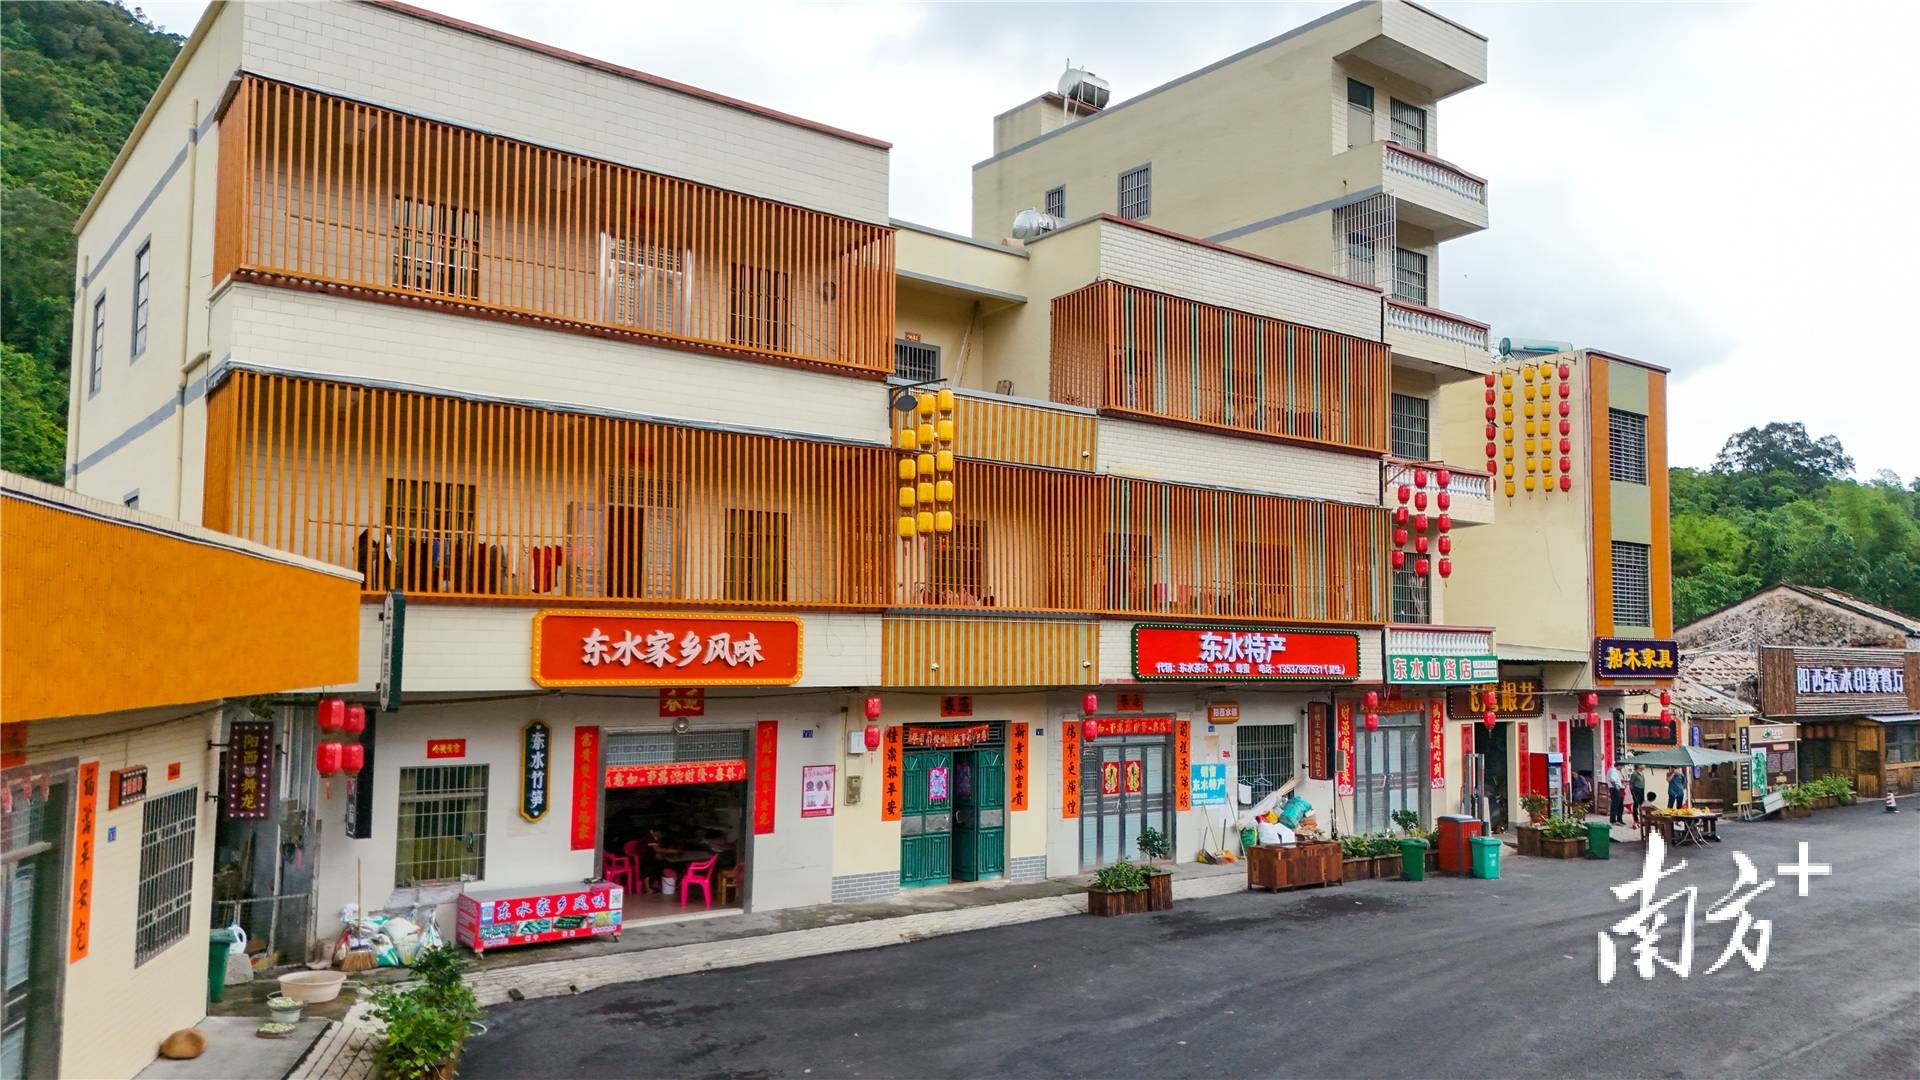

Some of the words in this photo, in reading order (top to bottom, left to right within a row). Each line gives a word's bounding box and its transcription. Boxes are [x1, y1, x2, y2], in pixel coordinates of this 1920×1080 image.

[582, 628, 765, 668] 东水家乡风味
[1200, 632, 1286, 663] 东水特产
[1605, 647, 1674, 670] 船木家具
[1392, 658, 1473, 680] 东水山货店
[1796, 667, 1905, 694] 阳西东水印象餐厅
[530, 731, 546, 809] 东水竹笋
[497, 892, 607, 921] 东水家乡风味
